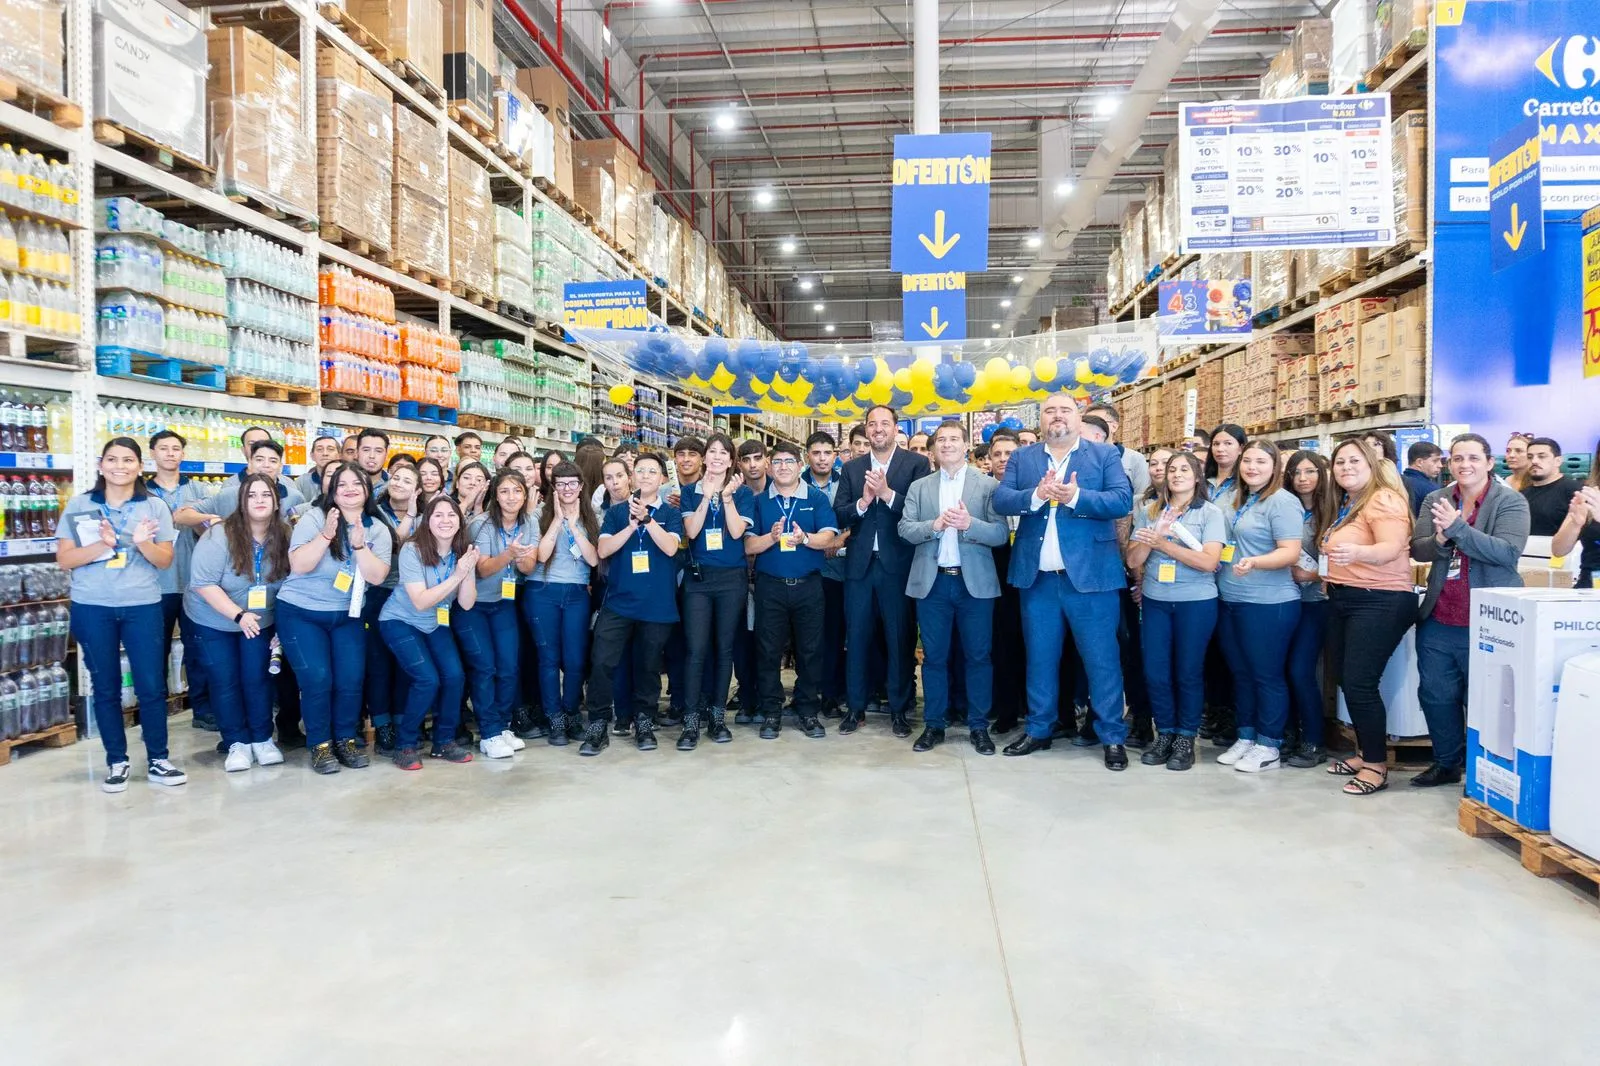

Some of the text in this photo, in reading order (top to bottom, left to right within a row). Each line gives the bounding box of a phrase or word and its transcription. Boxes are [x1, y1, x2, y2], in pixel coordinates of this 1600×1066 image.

[1446, 7, 1454, 18] 1
[114, 36, 150, 63] CANDY
[1321, 101, 1356, 110] Carrefour
[1523, 96, 1600, 117] Carrefo
[1332, 110, 1355, 118] MAXI
[893, 154, 991, 186] OFERTÓN
[1461, 166, 1485, 174] Para
[1542, 164, 1567, 173] milia
[1570, 164, 1585, 172] sin
[1195, 185, 1202, 194] 3
[1458, 195, 1482, 203] Para
[1550, 194, 1570, 202] con
[1350, 206, 1357, 215] 3
[902, 271, 966, 292] OFERTÓN
[631, 297, 637, 305] Y
[638, 296, 646, 305] EL
[1167, 294, 1198, 312] 43
[564, 304, 648, 330] COMPRÓN
[1100, 336, 1144, 344] Productos
[1479, 603, 1519, 626] PHILCO
